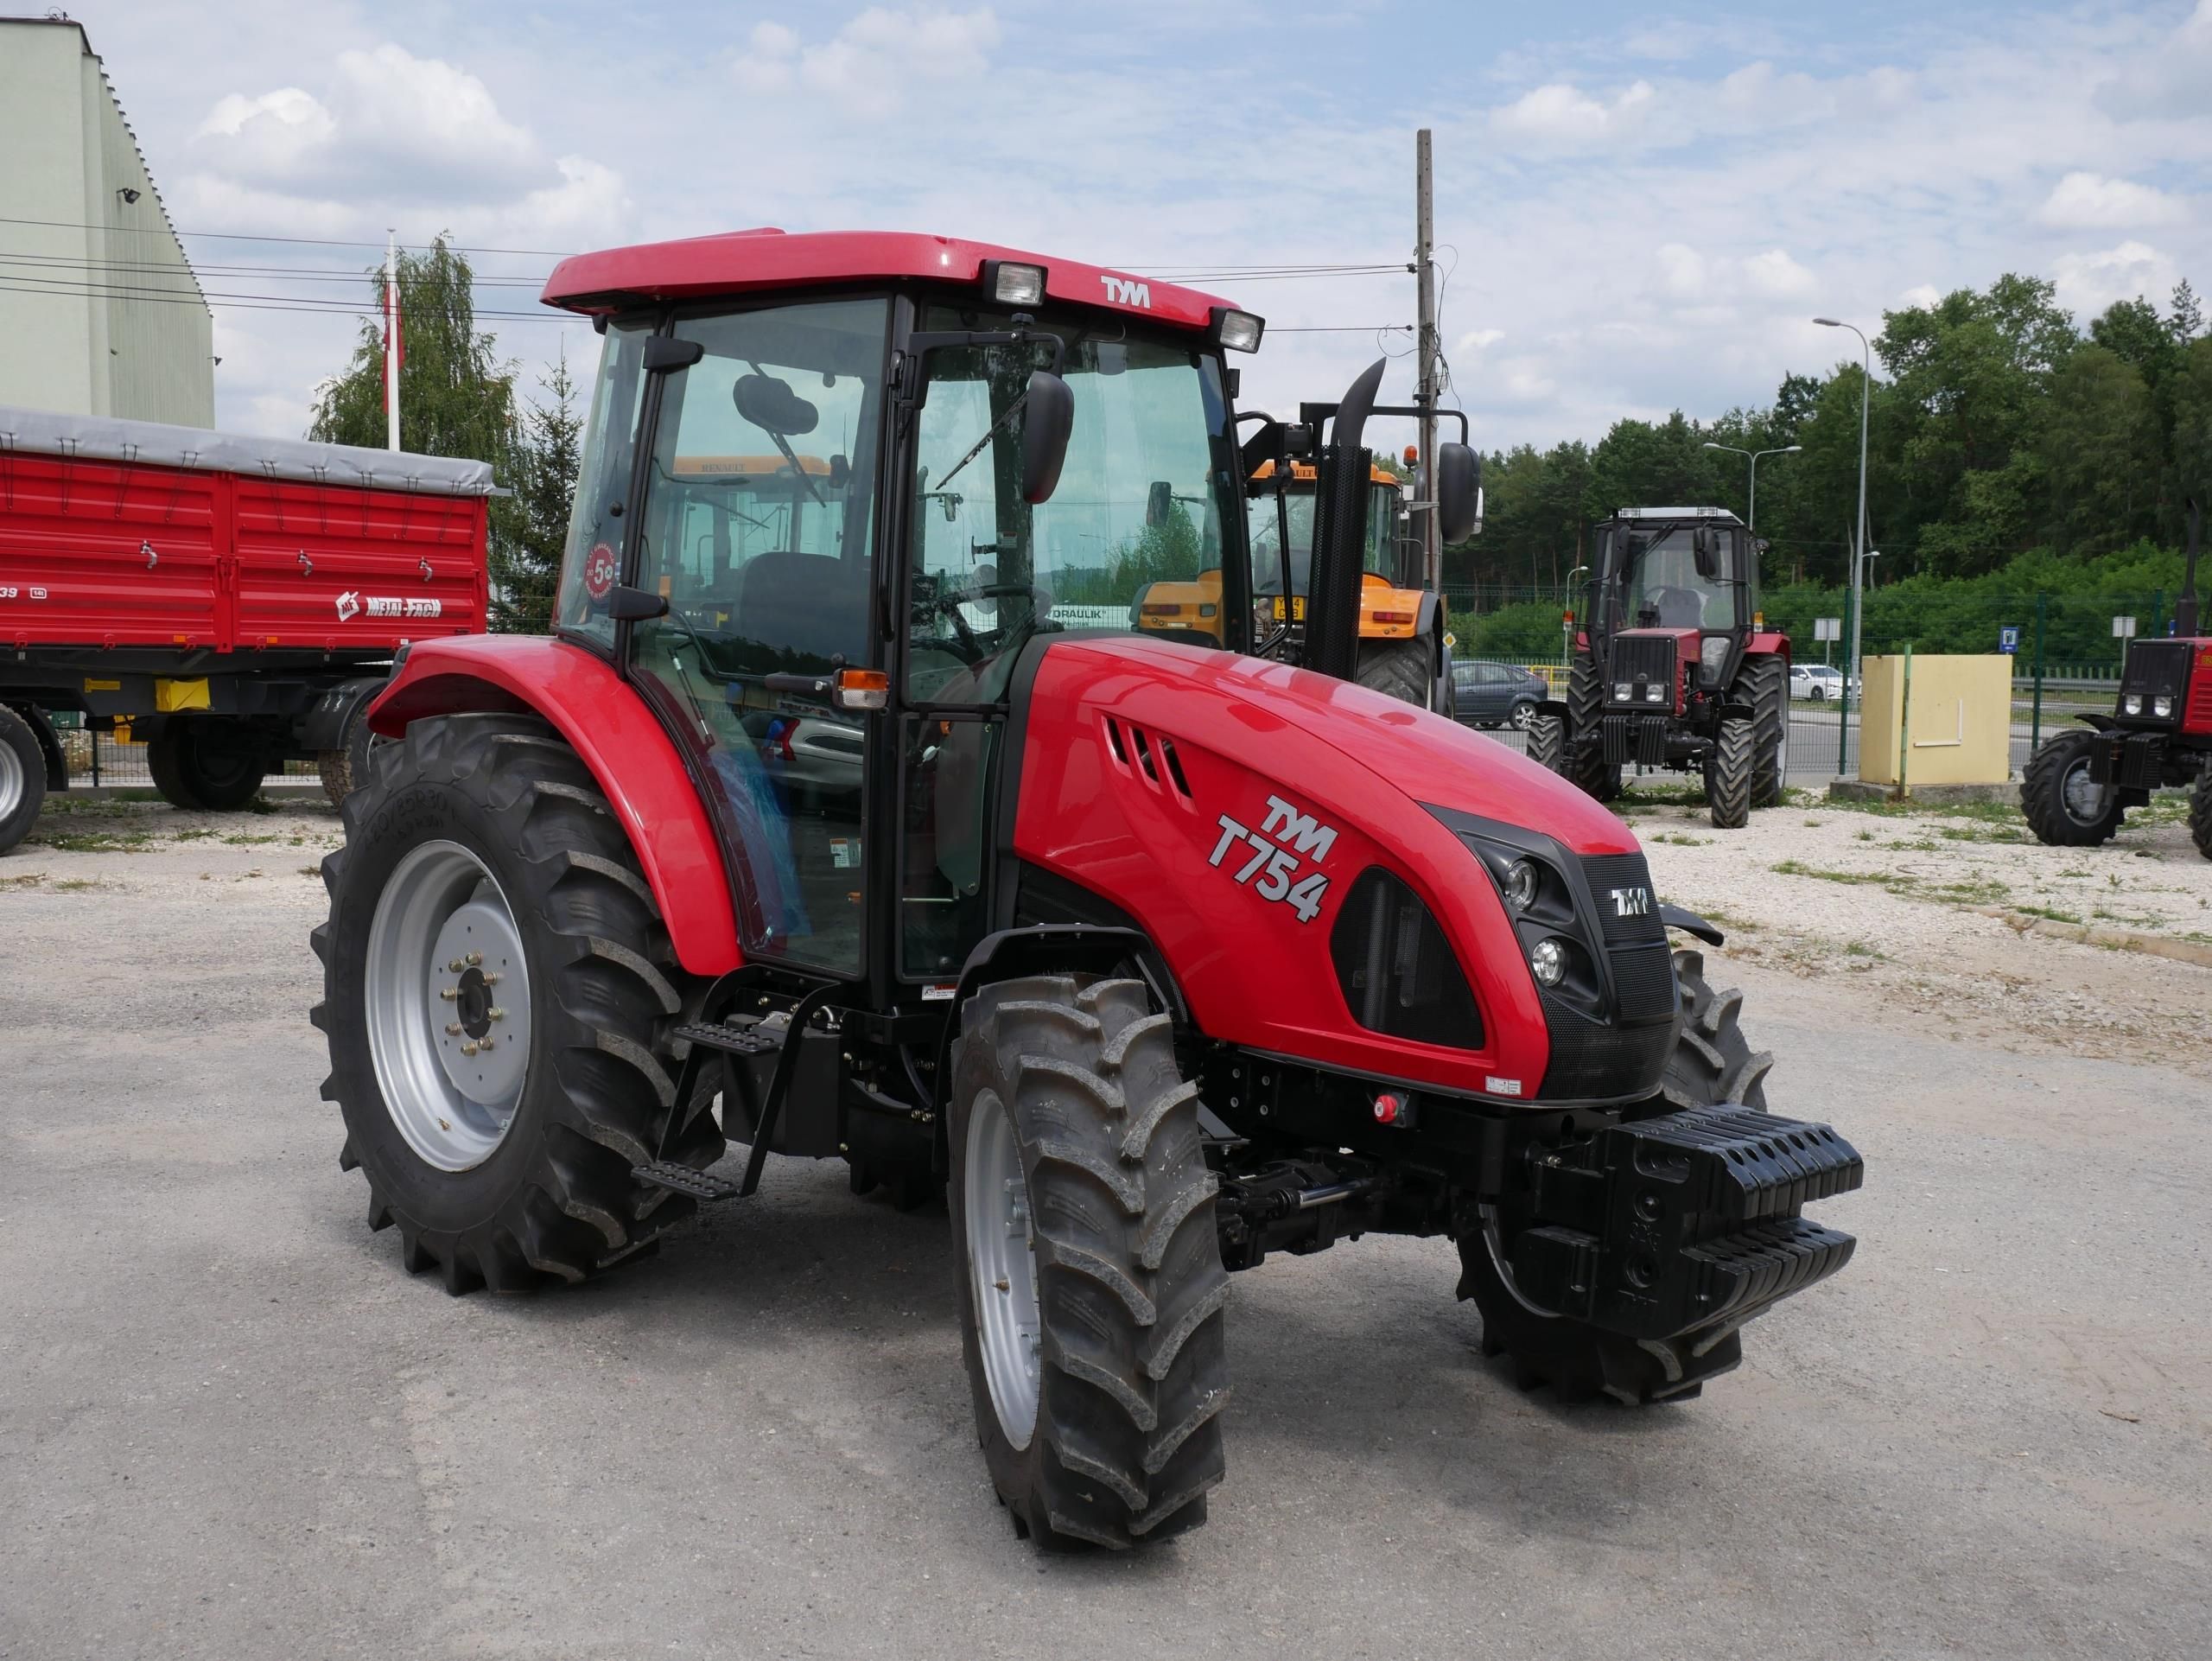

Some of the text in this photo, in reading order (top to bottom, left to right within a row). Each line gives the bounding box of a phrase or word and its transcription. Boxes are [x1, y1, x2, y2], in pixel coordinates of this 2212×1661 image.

[1101, 276, 1151, 309] TYM
[594, 559, 604, 584] 5
[365, 596, 442, 617] METAL-FACH
[1260, 794, 1339, 864] TYM
[1208, 813, 1332, 924] T754
[1611, 888, 1649, 916] TYM
